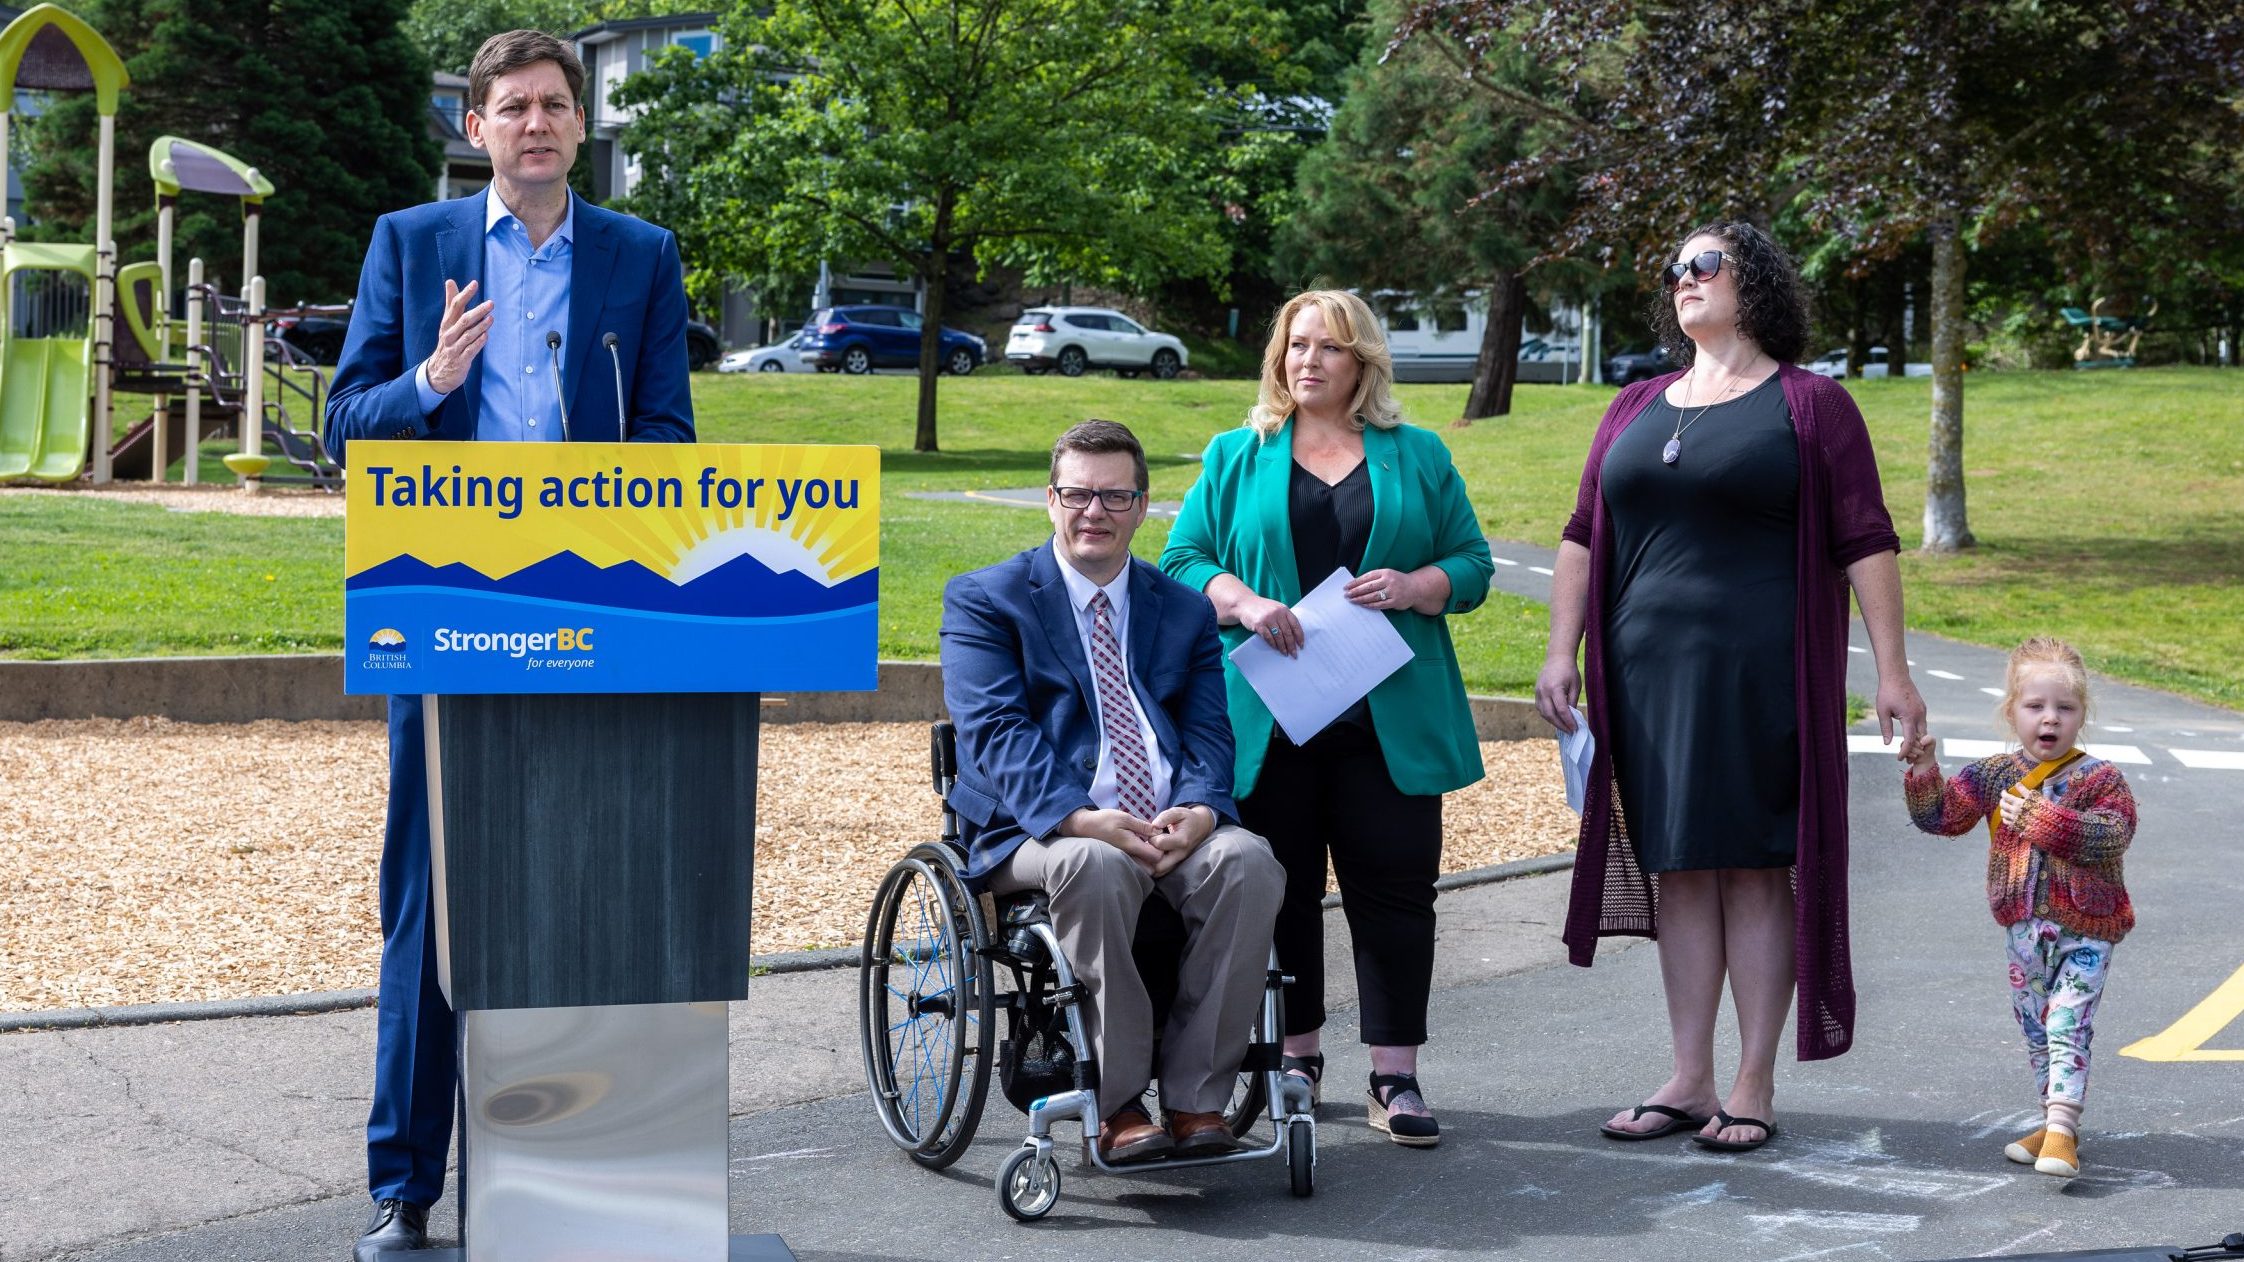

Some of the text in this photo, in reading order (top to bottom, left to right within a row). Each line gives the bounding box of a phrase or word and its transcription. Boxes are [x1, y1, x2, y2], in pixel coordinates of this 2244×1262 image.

[366, 465, 859, 520] Taking action for you
[434, 628, 594, 658] StrongerBC
[369, 653, 406, 661] BRITISH
[526, 657, 594, 670] for everyone
[363, 660, 412, 669] COLUMBIA
